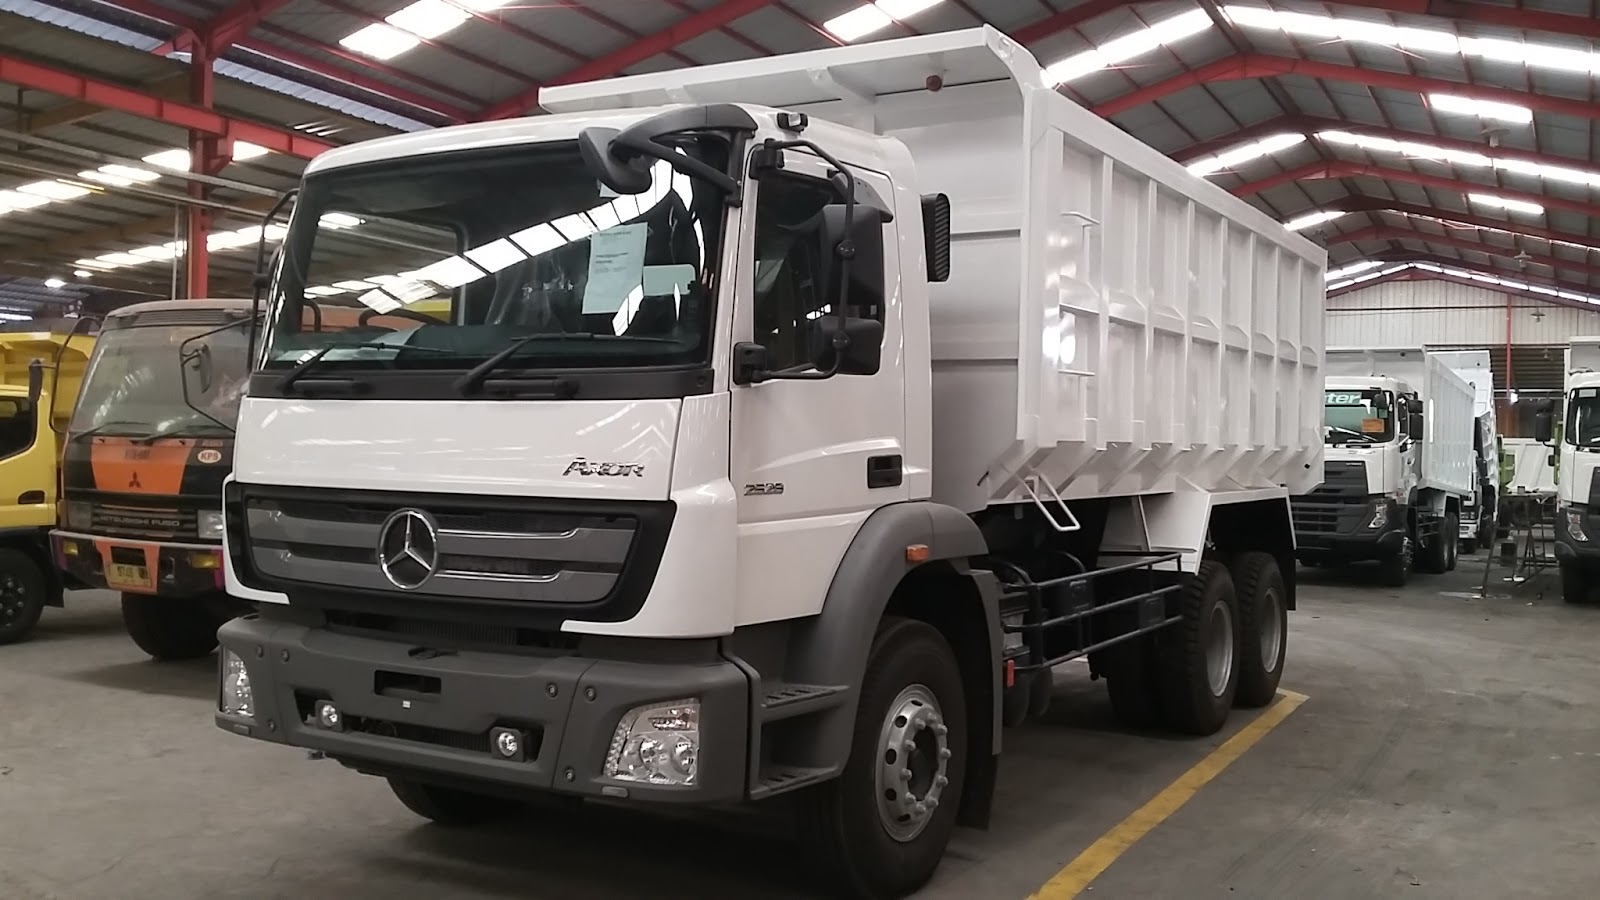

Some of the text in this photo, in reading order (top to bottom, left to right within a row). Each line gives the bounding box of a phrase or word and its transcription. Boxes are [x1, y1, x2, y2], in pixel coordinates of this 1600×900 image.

[1325, 393, 1361, 404] ter
[201, 450, 219, 460] KPS
[744, 483, 784, 496] 2528
